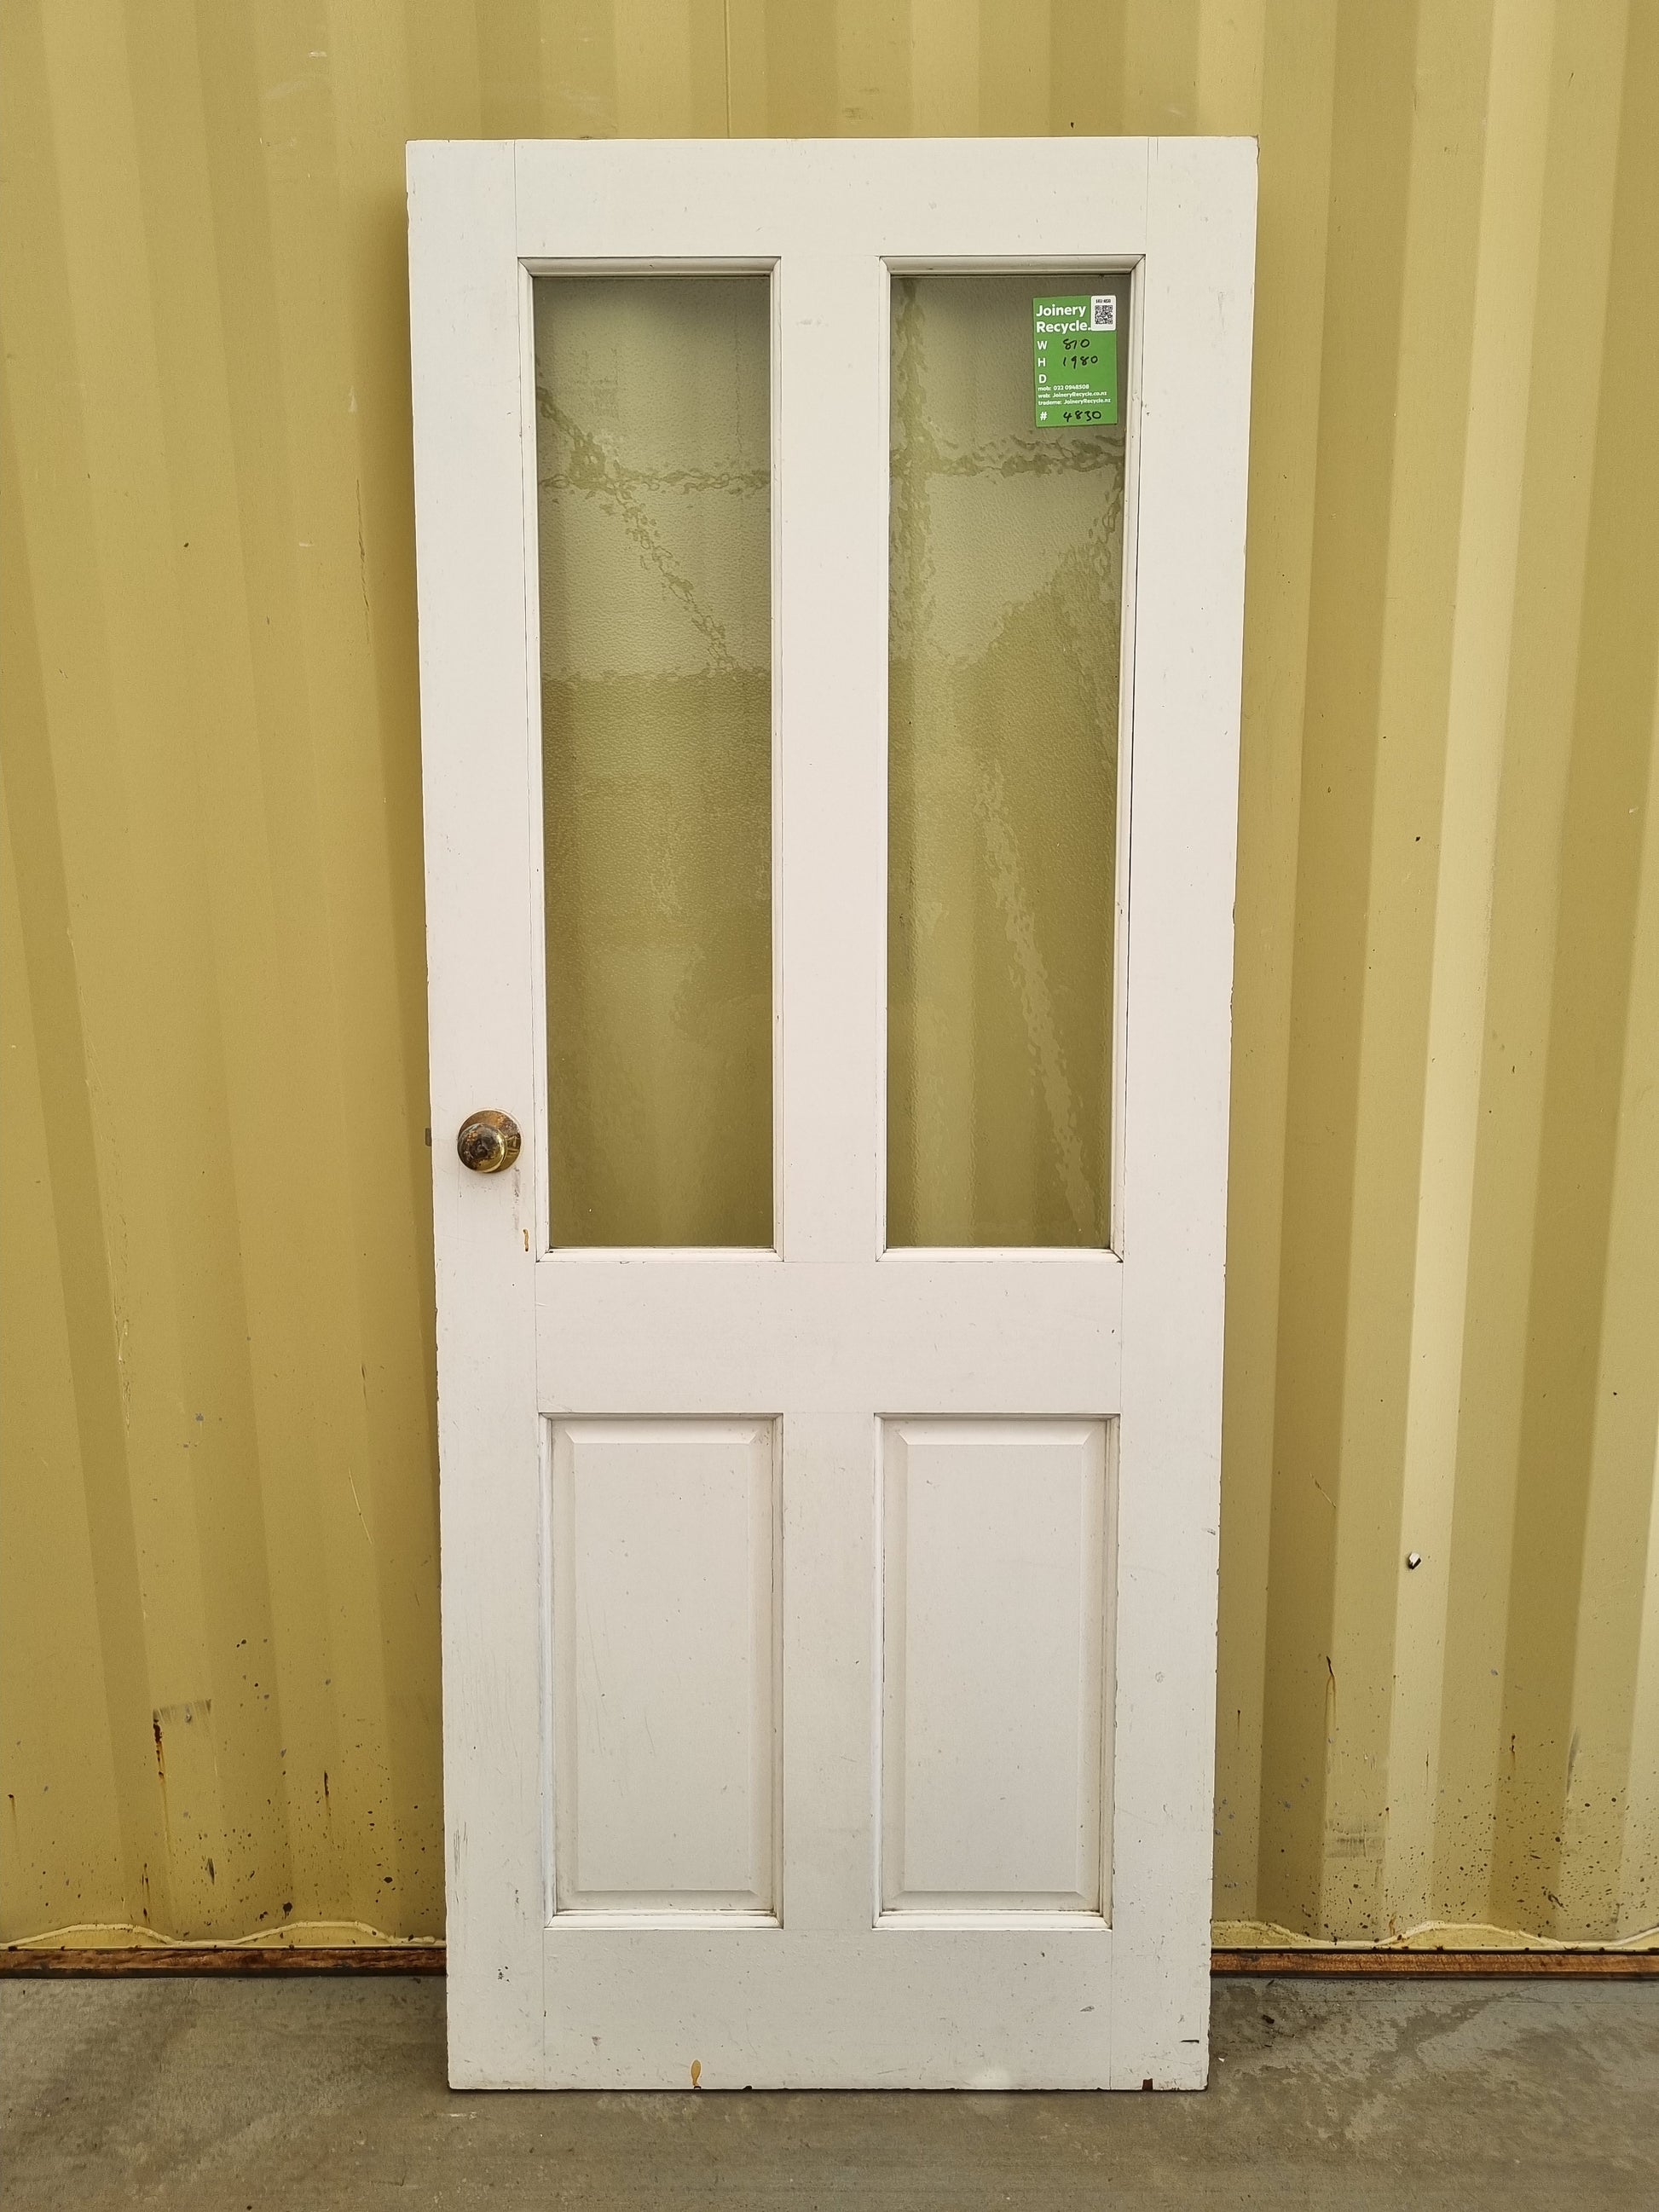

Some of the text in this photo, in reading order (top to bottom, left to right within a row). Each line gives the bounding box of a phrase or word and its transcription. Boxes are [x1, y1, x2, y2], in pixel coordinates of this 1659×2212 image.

[1036, 303, 1086, 317] Joinery
[1036, 320, 1091, 334] Recycle.
[1037, 341, 1048, 350] W
[1063, 338, 1090, 350] 810
[1038, 357, 1046, 367] H
[1063, 355, 1098, 370] 1980
[1038, 373, 1047, 384] D
[1039, 411, 1048, 421] #
[1063, 410, 1102, 423] 4830
